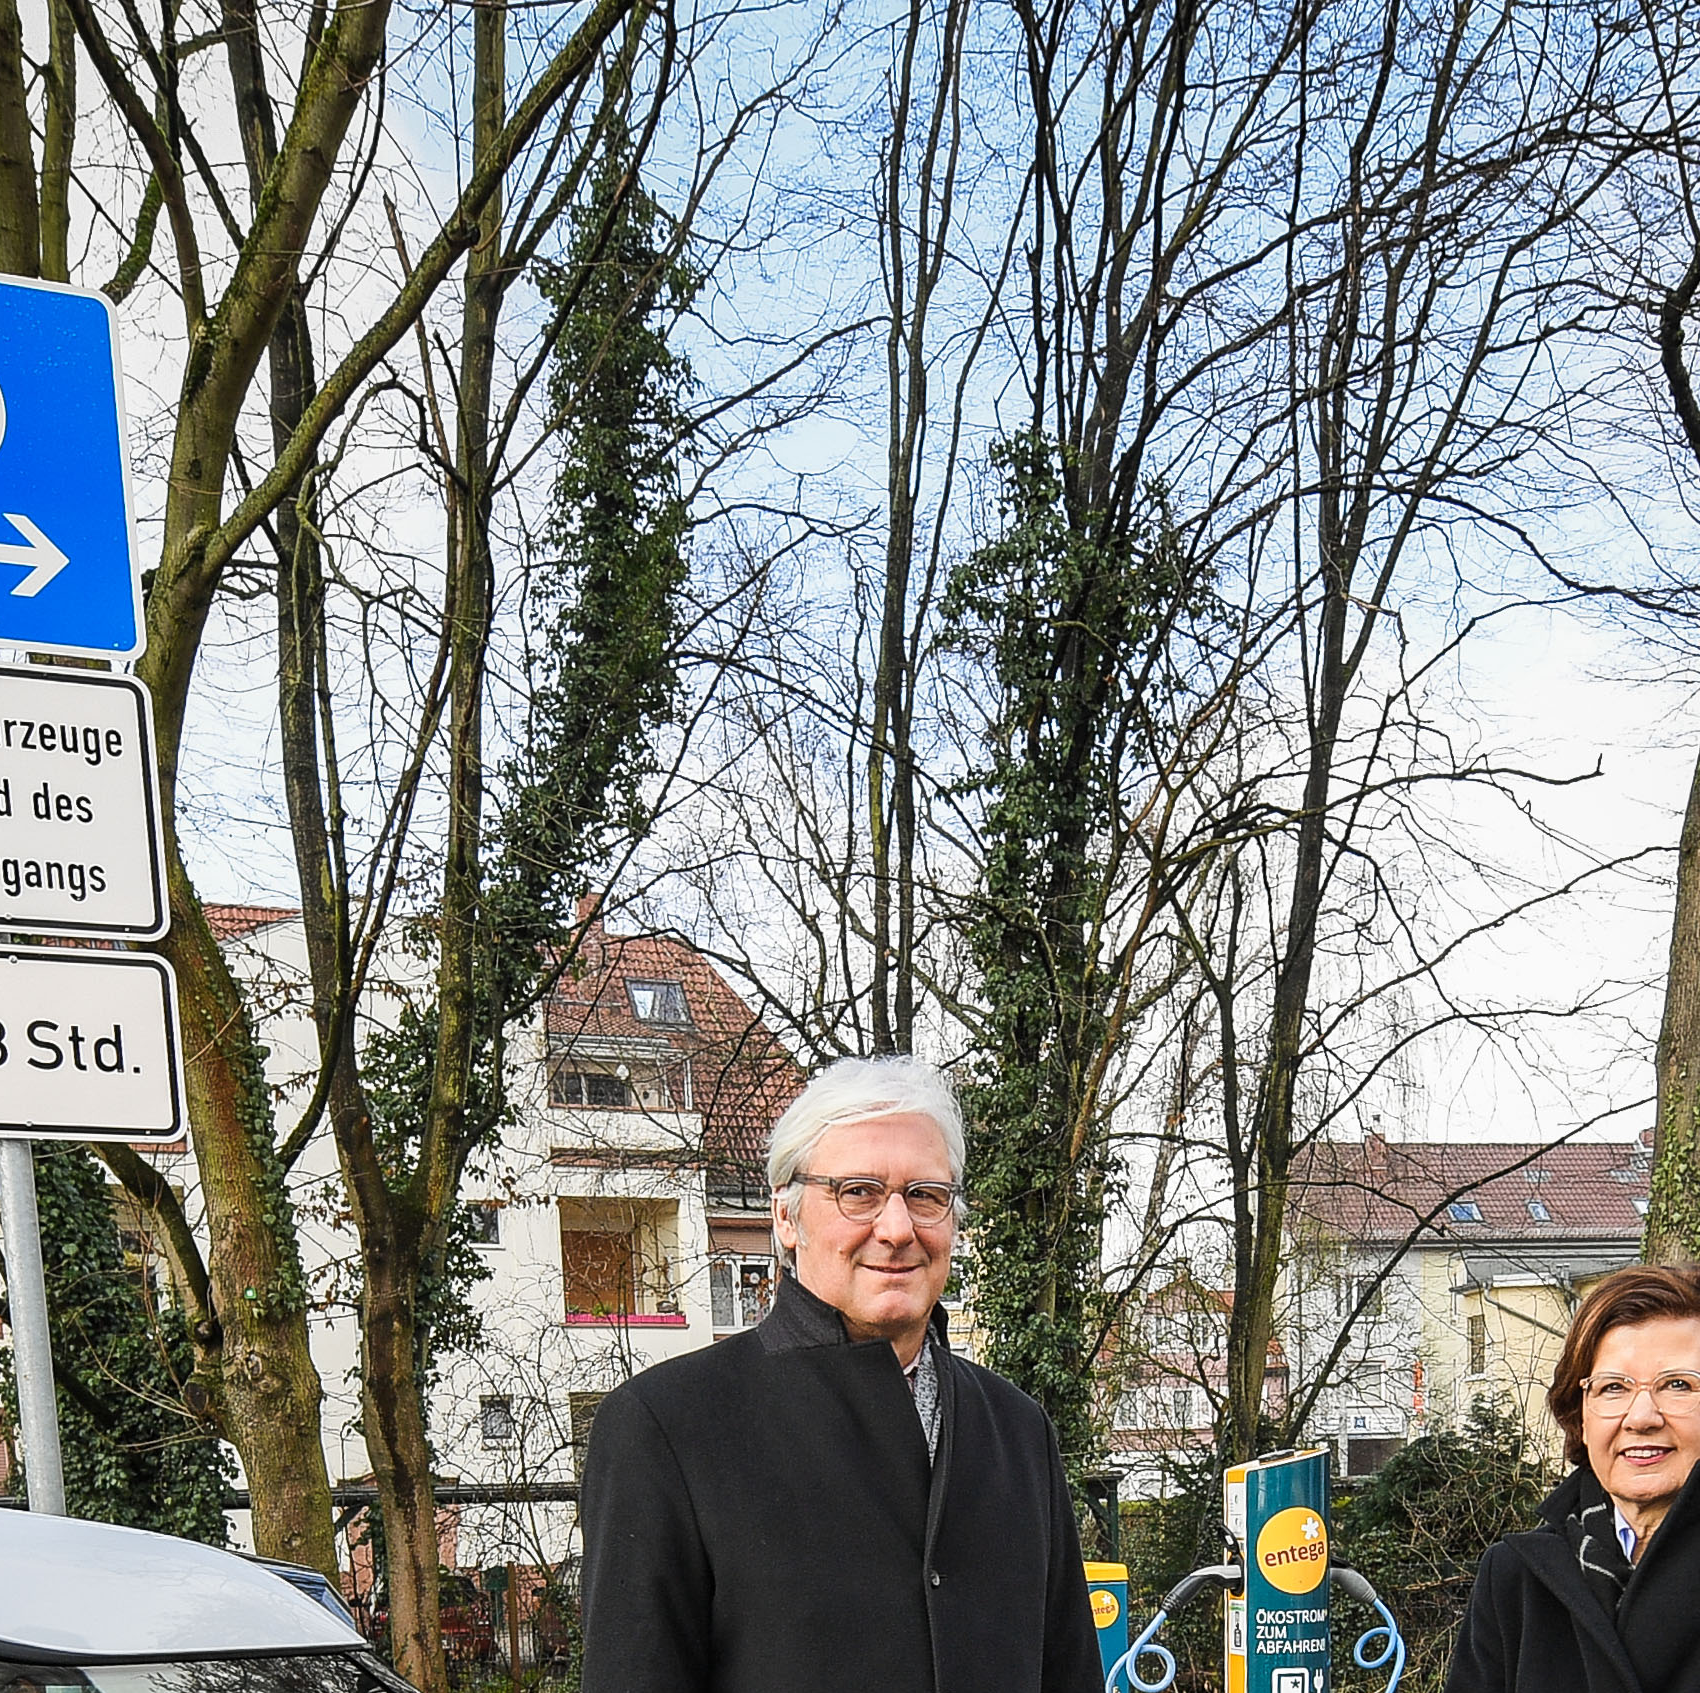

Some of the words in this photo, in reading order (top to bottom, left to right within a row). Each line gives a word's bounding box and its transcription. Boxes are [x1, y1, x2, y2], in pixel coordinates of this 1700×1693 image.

[32, 782, 94, 823] des
[26, 1020, 141, 1074] Std.
[1264, 1541, 1325, 1567] entega
[1256, 1625, 1287, 1639] ZUM
